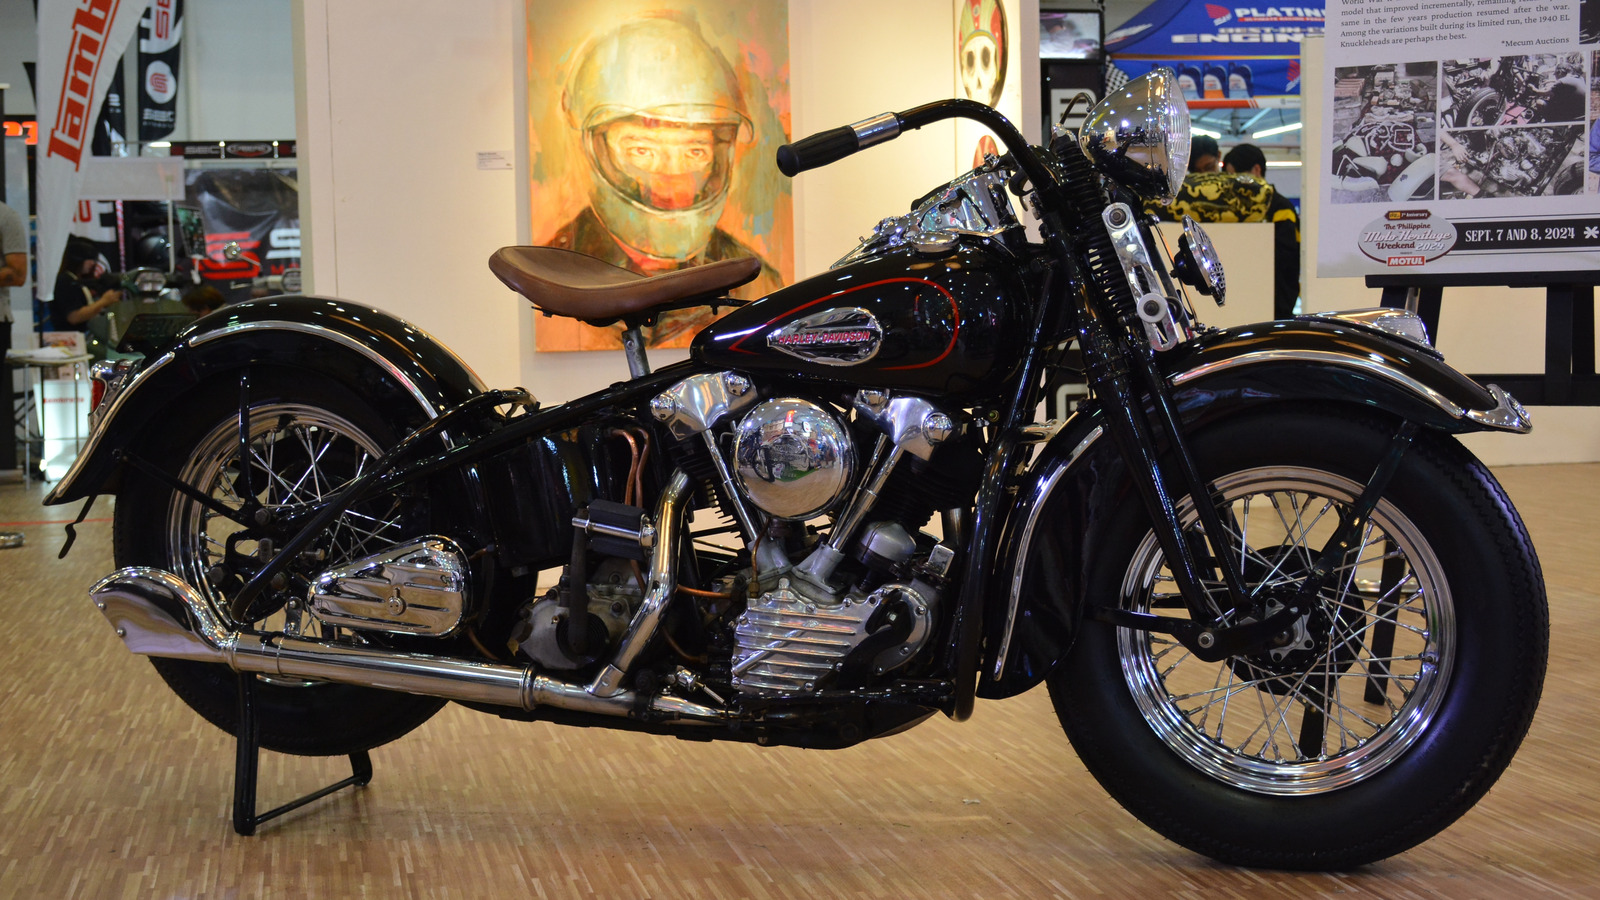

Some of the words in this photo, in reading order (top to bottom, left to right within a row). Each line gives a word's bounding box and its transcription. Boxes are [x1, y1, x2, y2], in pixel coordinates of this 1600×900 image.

[1342, 8, 1363, 16] model
[1384, 4, 1418, 13] improved
[1421, 0, 1474, 9] incrementally,
[1408, 15, 1427, 23] years
[1432, 11, 1472, 21] production
[1477, 8, 1509, 16] resumed
[1382, 26, 1418, 34] variations
[1439, 22, 1464, 30] during
[1478, 19, 1504, 27] limited
[1340, 38, 1390, 48] Knuckleheads
[1404, 36, 1434, 44] perhaps
[1535, 37, 1570, 45] Auctions
[1397, 222, 1431, 230] Philippine
[1364, 231, 1398, 243] Moto
[1399, 230, 1452, 242] Heritage
[1465, 229, 1494, 242] SEPT.
[1497, 229, 1503, 240] 7
[1506, 228, 1527, 240] AND
[1530, 228, 1542, 240] 8,
[1545, 227, 1575, 239] 2024
[1376, 242, 1415, 250] Weekend
[1415, 242, 1446, 251] 2024
[1389, 257, 1423, 265] MOTUL
[778, 331, 870, 344] HARLEY-DAVIDSON
